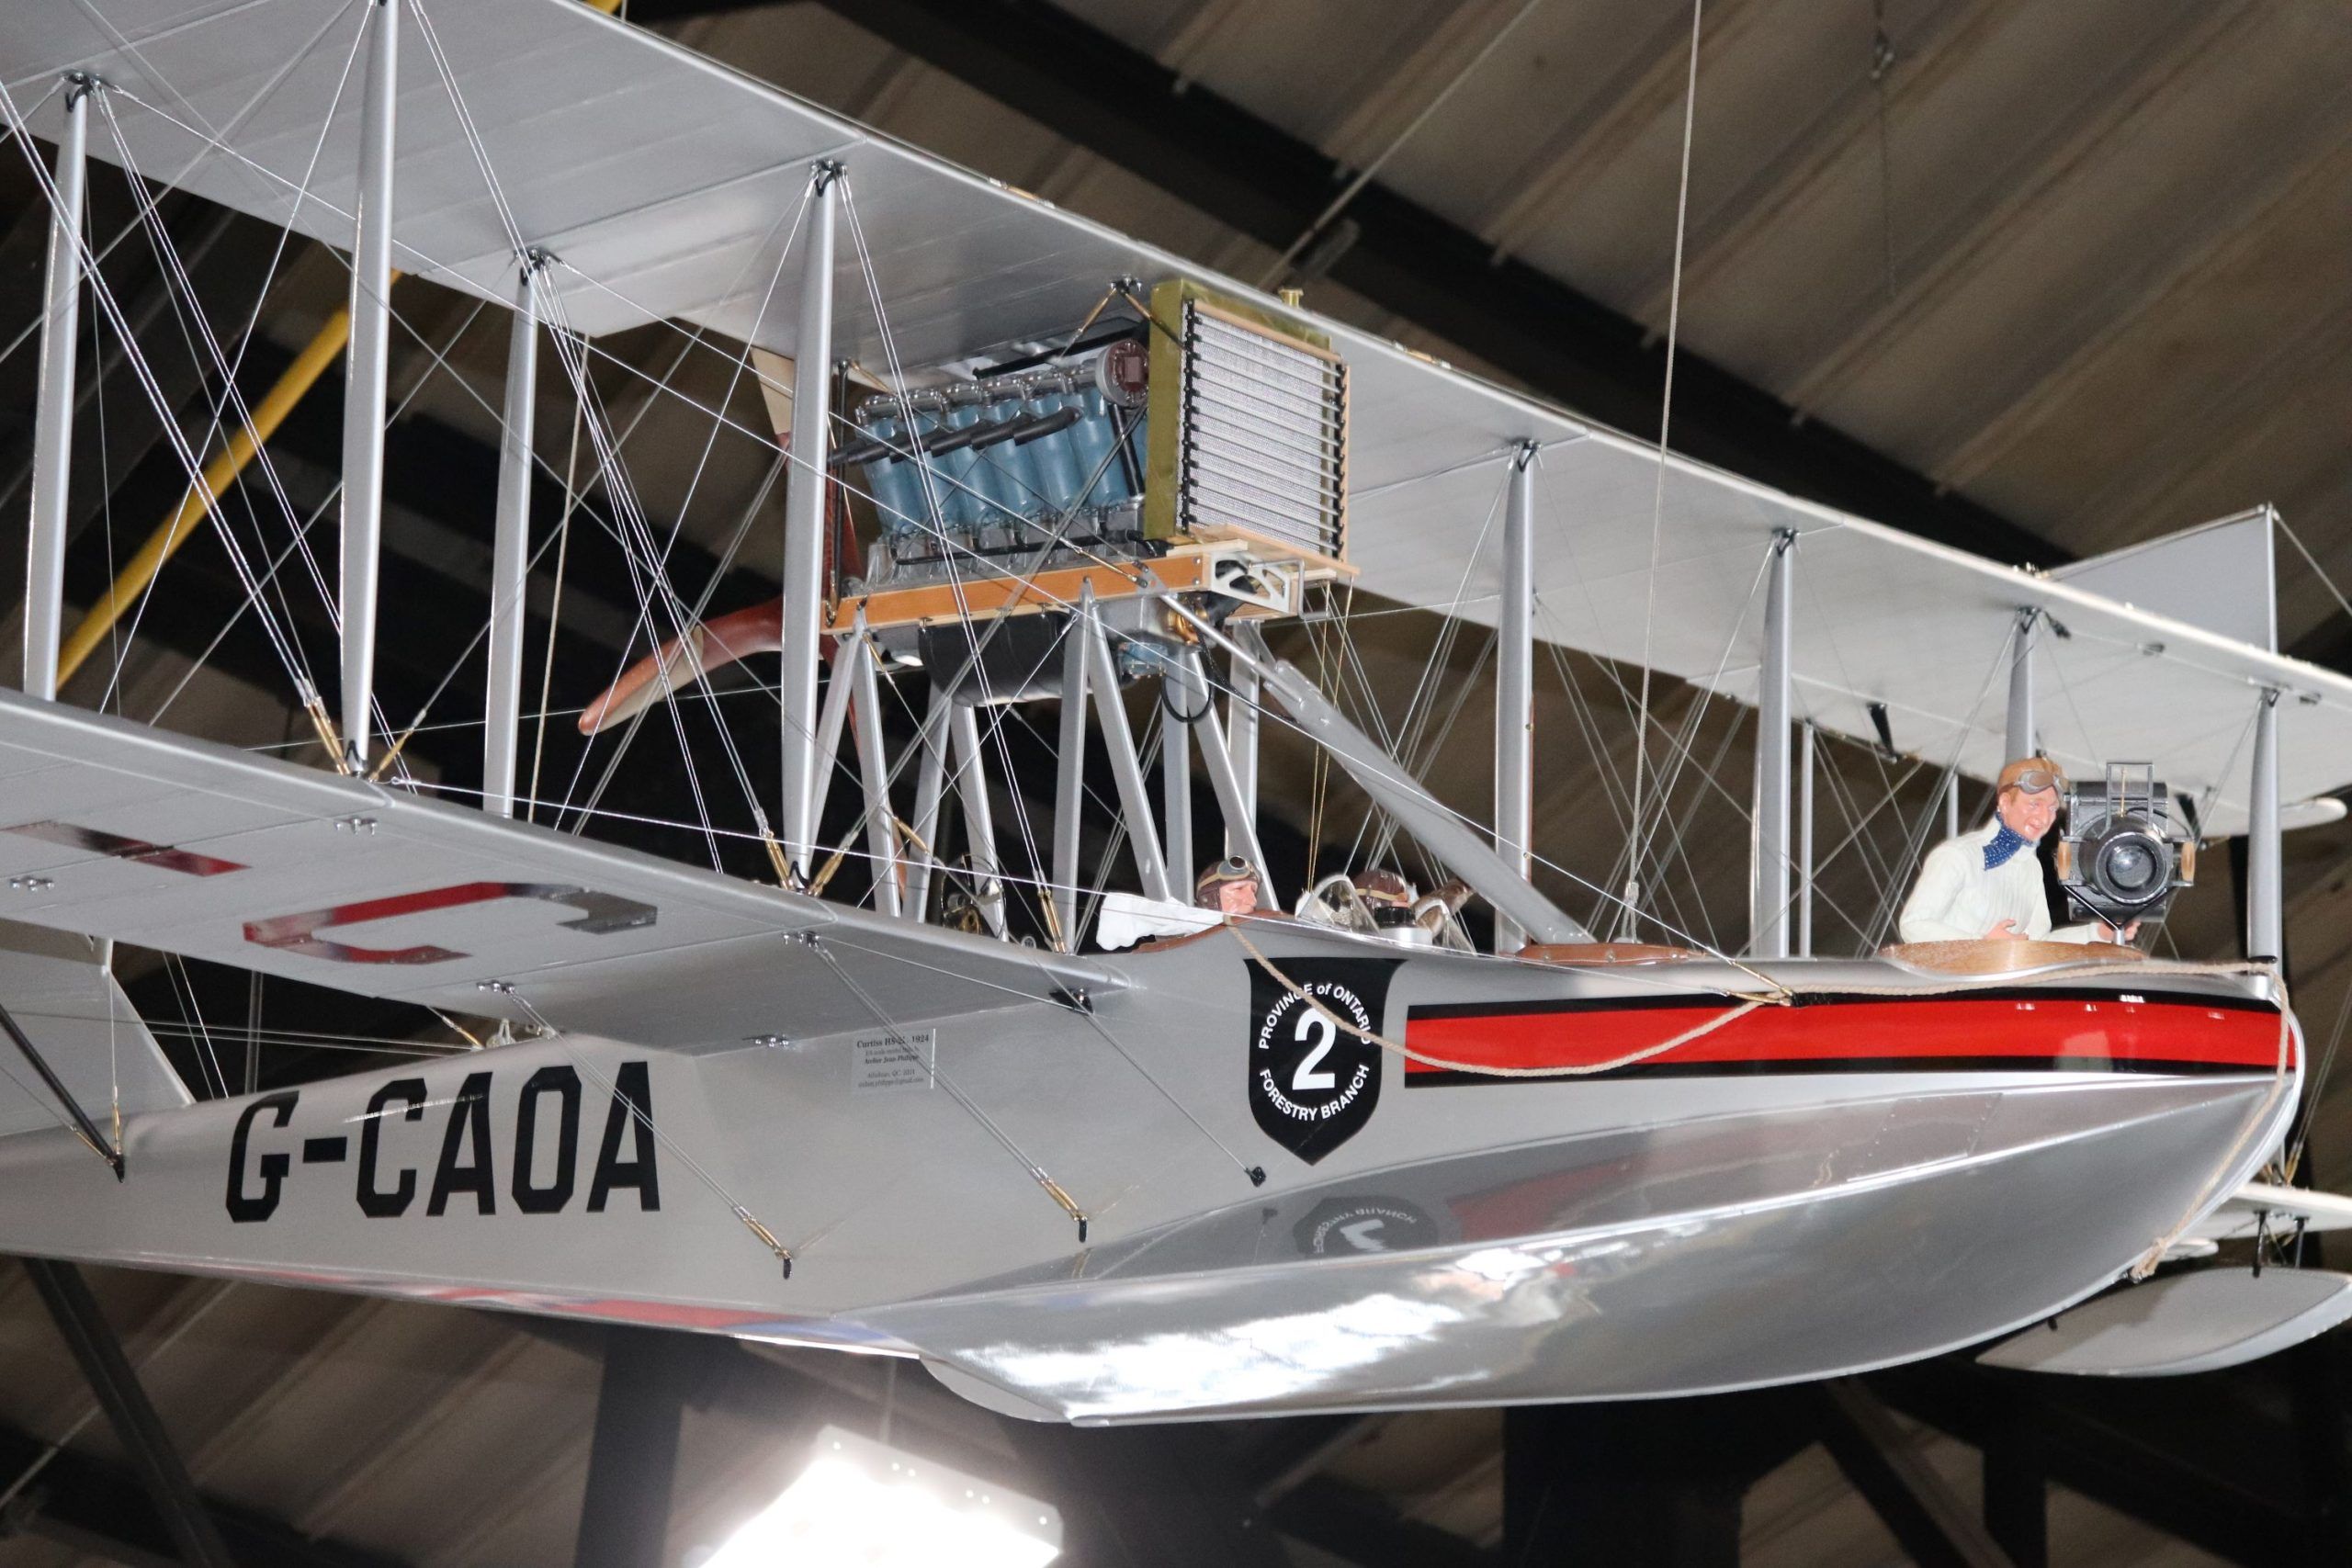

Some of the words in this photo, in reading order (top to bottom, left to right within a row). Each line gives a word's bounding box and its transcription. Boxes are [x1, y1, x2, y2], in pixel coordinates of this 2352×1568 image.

[1317, 983, 1332, 996] of
[856, 1039, 883, 1048] Curtiss
[1292, 1007, 1337, 1090] 2
[1259, 1068, 1318, 1122] FORESTRY
[1320, 1064, 1371, 1120] BRANCH
[226, 1060, 661, 1224] G-CAOA
